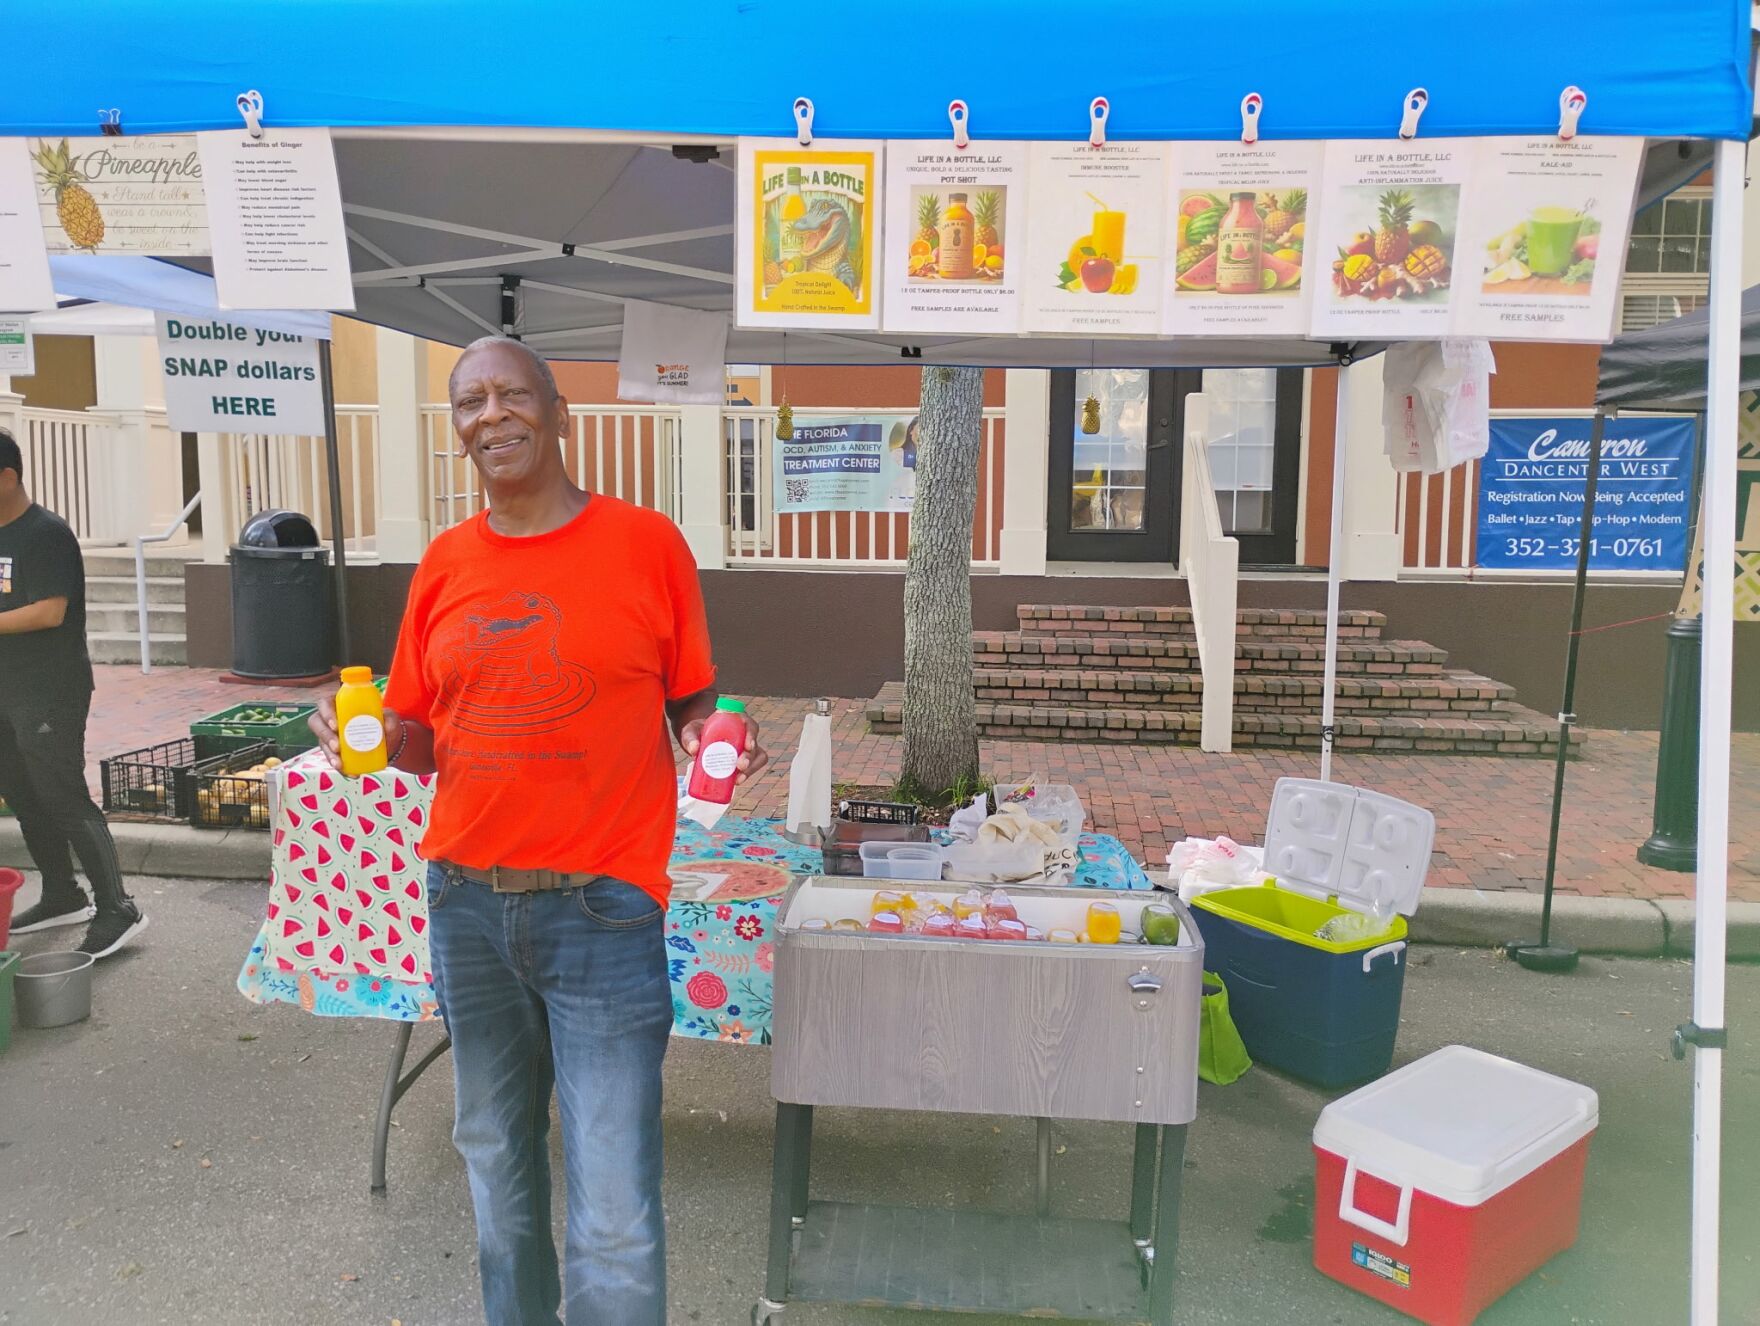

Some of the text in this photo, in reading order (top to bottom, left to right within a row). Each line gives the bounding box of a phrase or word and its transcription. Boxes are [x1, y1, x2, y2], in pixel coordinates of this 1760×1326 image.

[954, 156, 986, 164] BOTTLE,
[1377, 154, 1384, 162] IN
[1397, 154, 1432, 162] BOTTLE,
[84, 149, 202, 184] Pineapple
[763, 170, 864, 196] LIFE IN A BOTTLE
[1500, 313, 1565, 322] FREE SAMPLES
[167, 320, 247, 341] Double
[165, 357, 316, 381] SNAP dollars
[670, 372, 688, 380] GLAD
[212, 396, 276, 416] HERE
[805, 428, 848, 439] FLORIDA
[784, 446, 806, 454] OCD,
[1528, 429, 1647, 462] Camron
[784, 458, 880, 470] TREATMENT CENTER
[1505, 462, 1670, 477] DANCENTR WEST
[1488, 491, 1684, 505] Registration Now Being Accepted
[1488, 514, 1681, 526] Ballet Jazz Tap ip-Hop Modern
